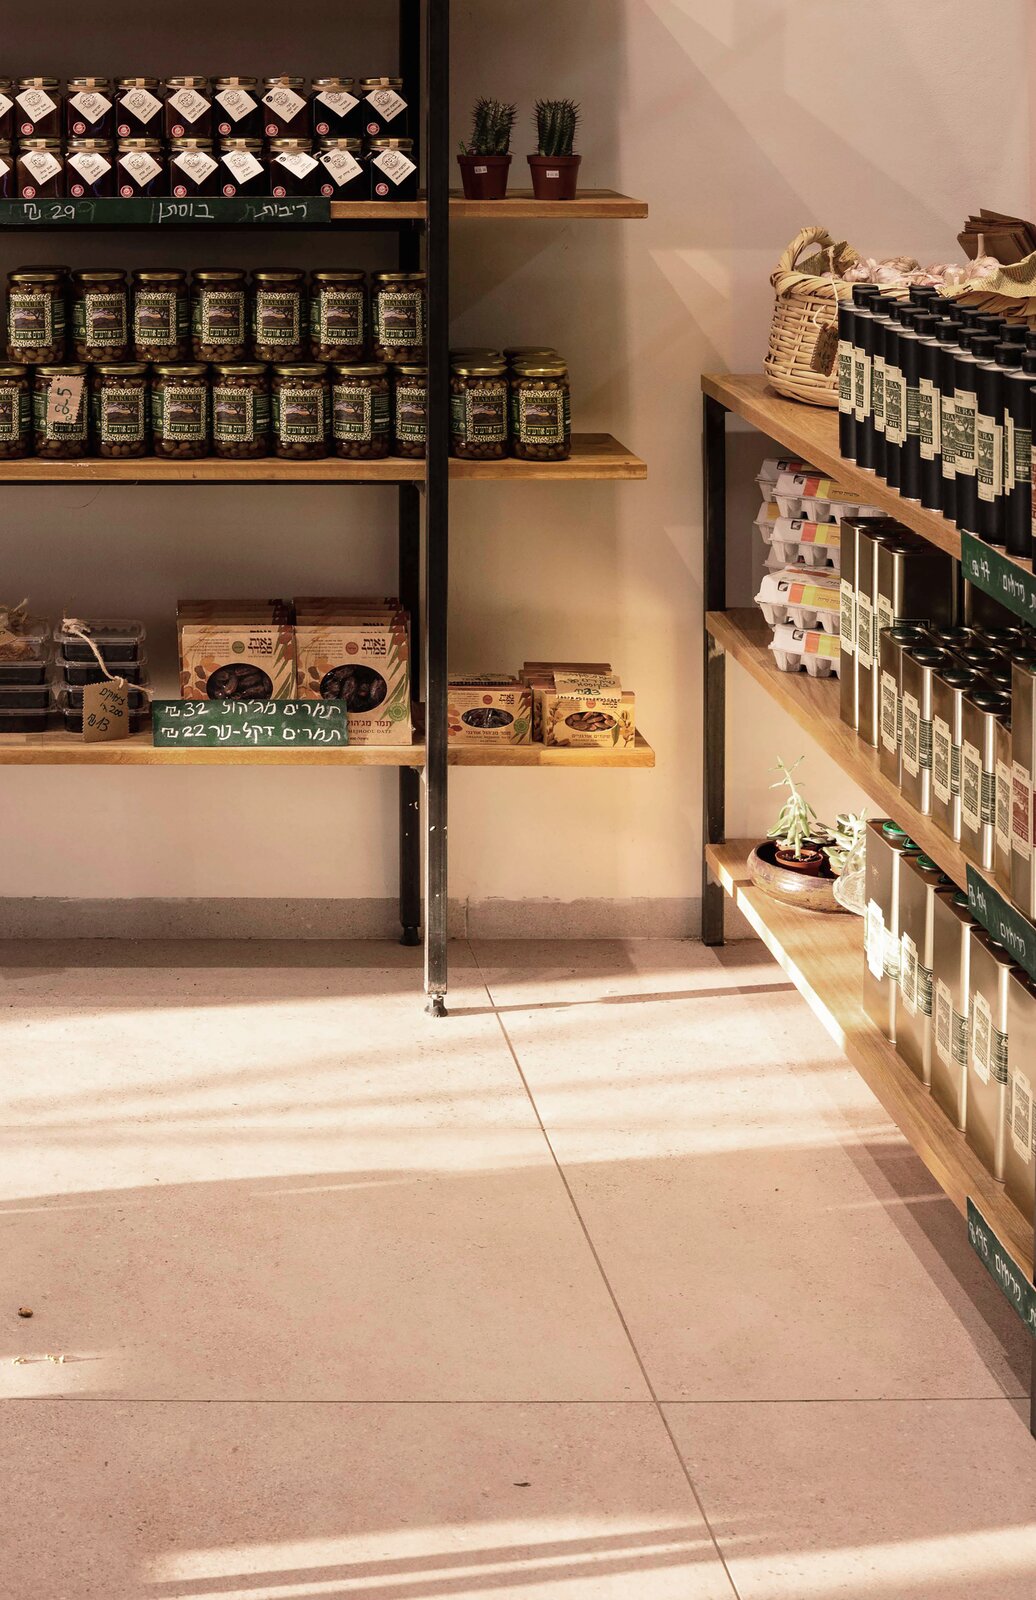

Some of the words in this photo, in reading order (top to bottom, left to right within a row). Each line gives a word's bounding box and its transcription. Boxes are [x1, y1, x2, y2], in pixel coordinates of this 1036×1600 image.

[51, 205, 76, 220] 29
[254, 204, 307, 218] ריבות
[961, 451, 973, 459] OIL
[981, 477, 992, 485] OIL
[283, 702, 341, 719] תמרים
[374, 719, 392, 727] תמר
[282, 727, 341, 742] תמרים
